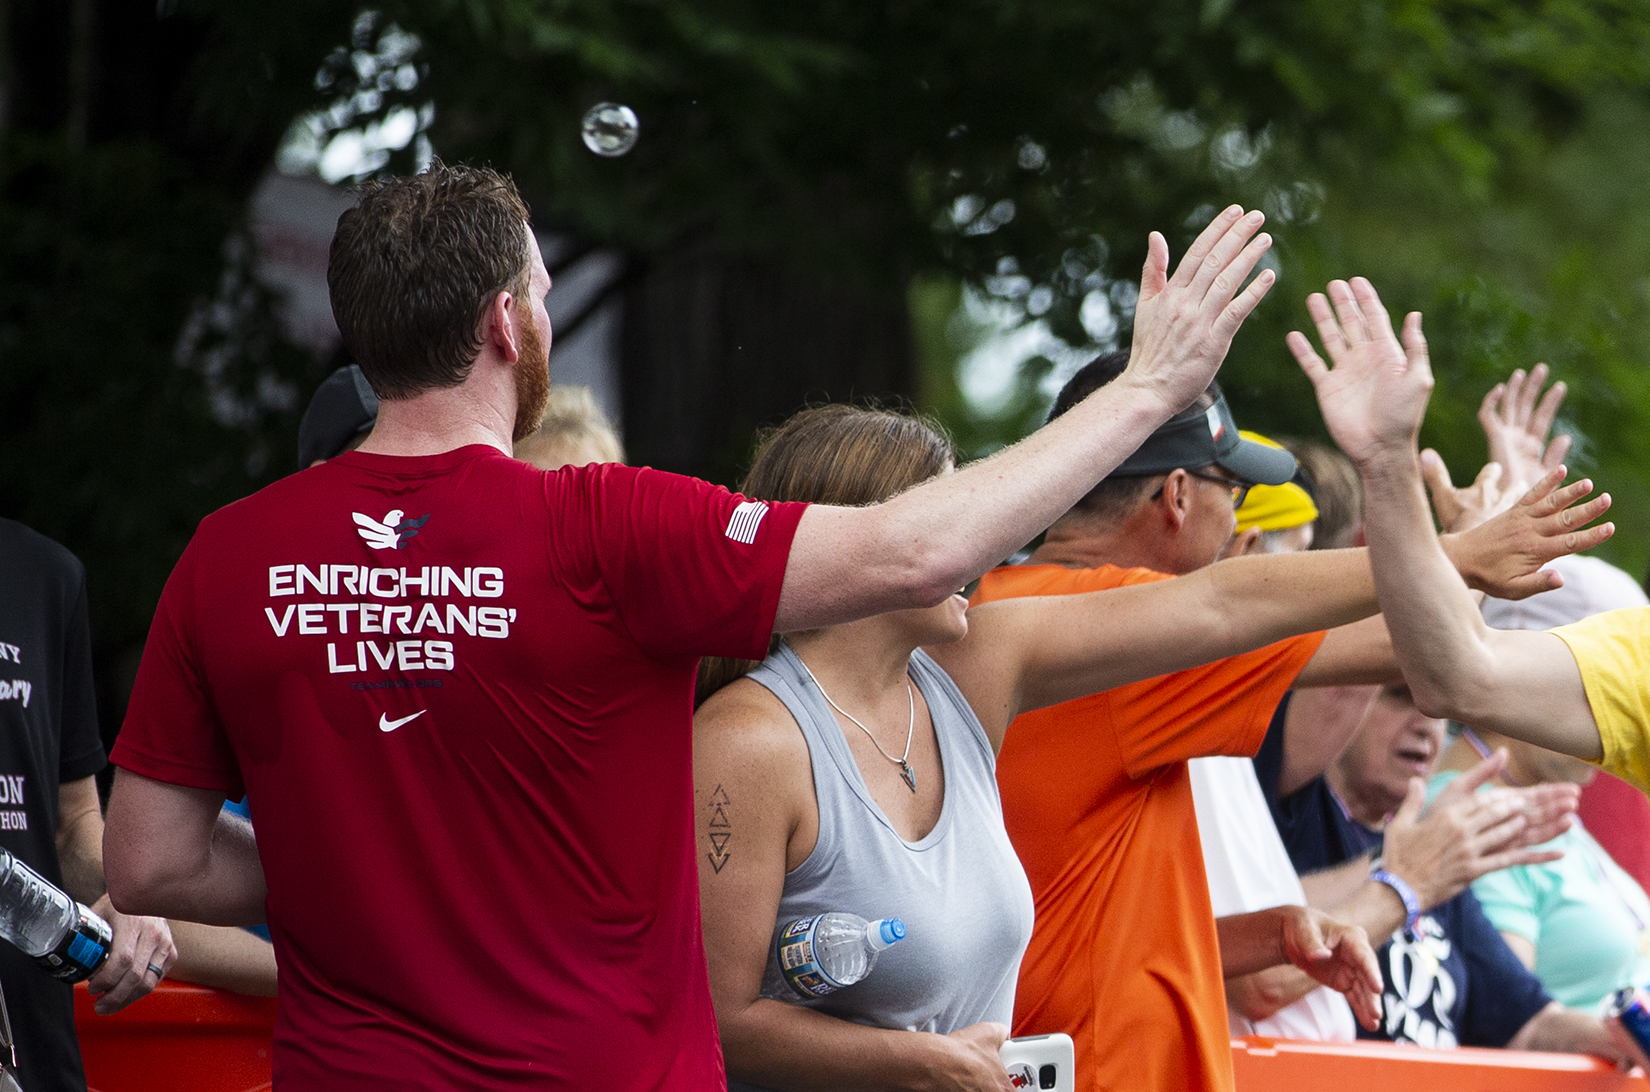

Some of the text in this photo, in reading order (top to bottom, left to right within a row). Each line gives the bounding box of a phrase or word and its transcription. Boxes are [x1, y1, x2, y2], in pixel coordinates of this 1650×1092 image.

[268, 564, 505, 598] ENRICHING
[264, 603, 518, 639] VETERANS'
[327, 640, 455, 673] LIVES
